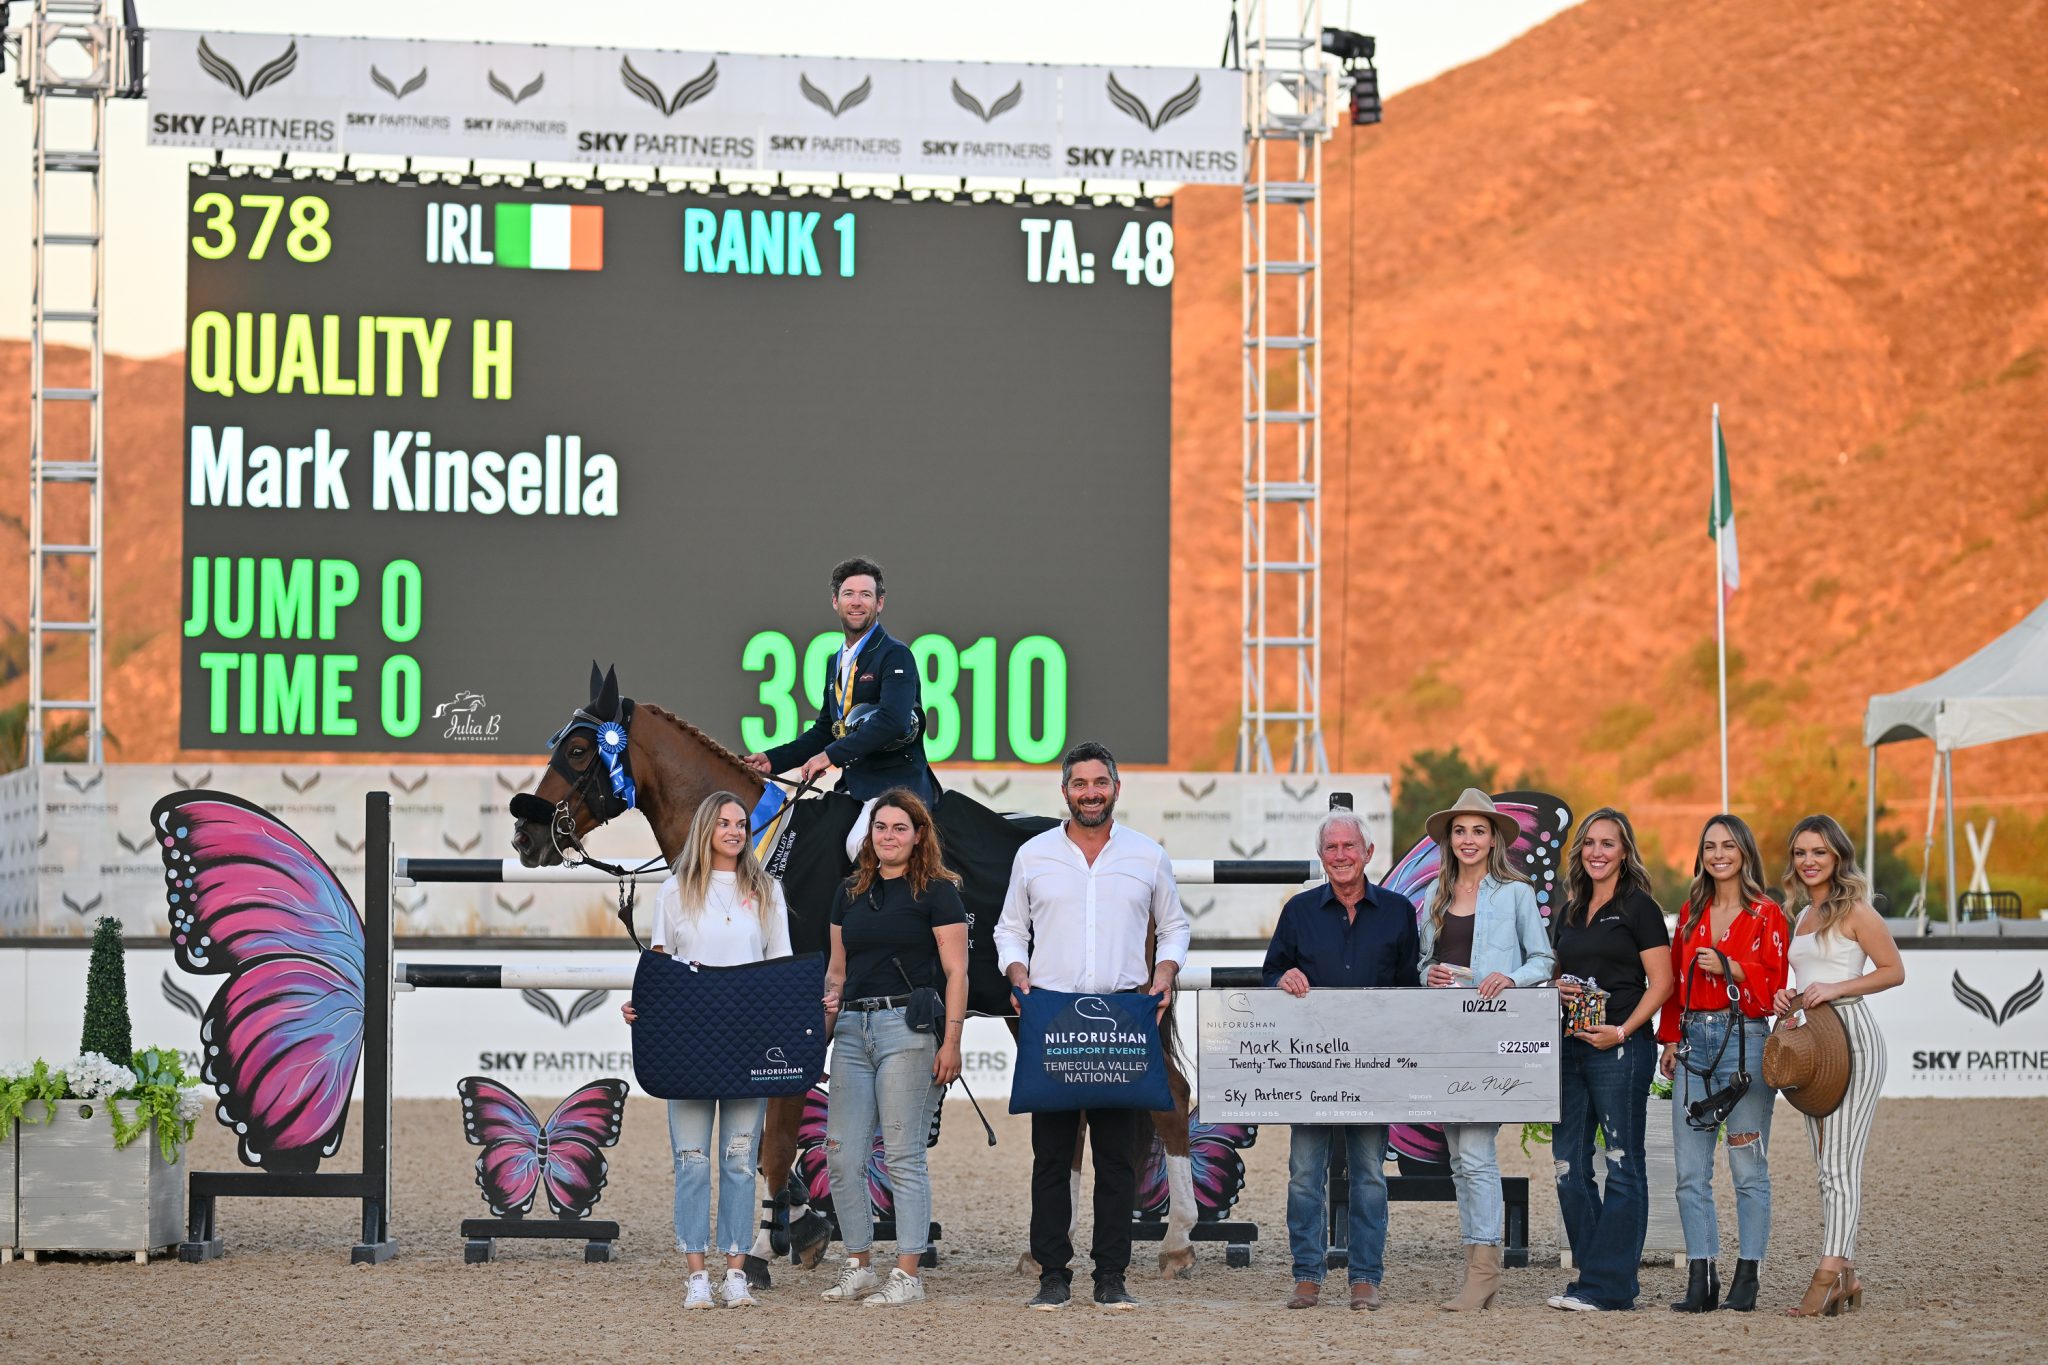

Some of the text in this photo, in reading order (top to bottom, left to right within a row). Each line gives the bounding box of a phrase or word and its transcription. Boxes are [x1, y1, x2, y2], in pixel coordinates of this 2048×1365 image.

[154, 113, 206, 135] SKY
[212, 116, 335, 141] PARTNERS
[347, 113, 449, 129] SKY PARTNERS
[464, 118, 567, 133] SKY PARTNERS
[578, 131, 628, 151] SKY
[635, 133, 755, 158] PARTNERS
[770, 135, 901, 155] SKY PARTNERS
[922, 141, 1051, 160] SKY PARTNERS
[1066, 147, 1114, 166] SKY
[1121, 149, 1237, 171] PARTNERS
[191, 192, 1175, 287] 378 IRL RANK 1 TA: 48
[190, 310, 512, 400] QUALITY H
[190, 425, 618, 517] Mark Kinsella
[184, 556, 422, 643] JUMP 0
[200, 652, 358, 736] TIME
[381, 654, 422, 738] 0
[1207, 1021, 1276, 1029] NILFORUSHAN
[1045, 1032, 1147, 1044] NILFORUSHAN
[1290, 1038, 1350, 1054] Kinsella
[1046, 1047, 1146, 1055] EQUISPORT EVENTS
[479, 1052, 526, 1070] SKY
[1043, 1061, 1149, 1071] TEMECULA VALLEY
[1289, 1057, 1332, 1069] Thousand
[1335, 1058, 1351, 1069] Five
[1355, 1057, 1390, 1069] Hundred
[1912, 1051, 1961, 1070] SKY
[751, 1067, 803, 1076] NILFORUSHAN
[1064, 1072, 1130, 1083] NATIONAL
[1254, 1087, 1303, 1101] Partners
[1310, 1090, 1361, 1102] Grand Prix
